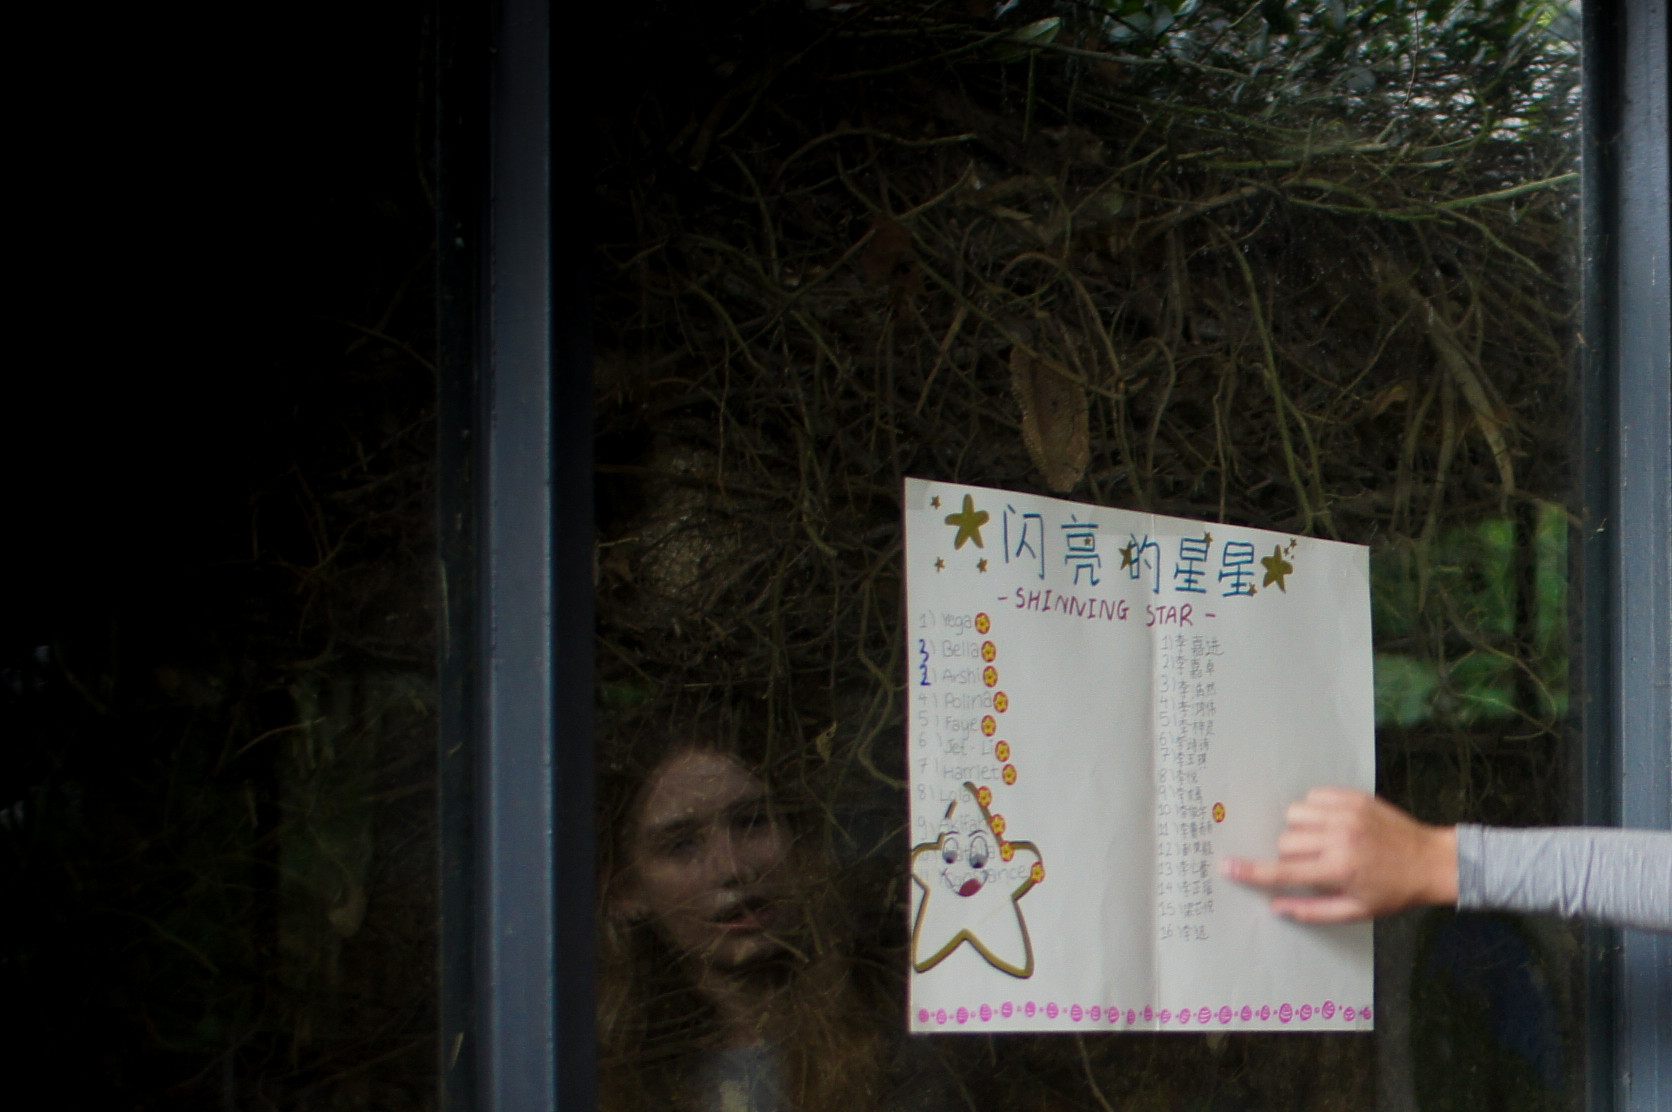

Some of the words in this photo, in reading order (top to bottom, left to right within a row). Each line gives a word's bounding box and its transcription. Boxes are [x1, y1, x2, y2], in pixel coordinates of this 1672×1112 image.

[1003, 504, 1255, 598] 闪亮的星星
[1015, 587, 1130, 622] SHINNING
[1145, 603, 1194, 628] STAR
[943, 640, 979, 658] Bella
